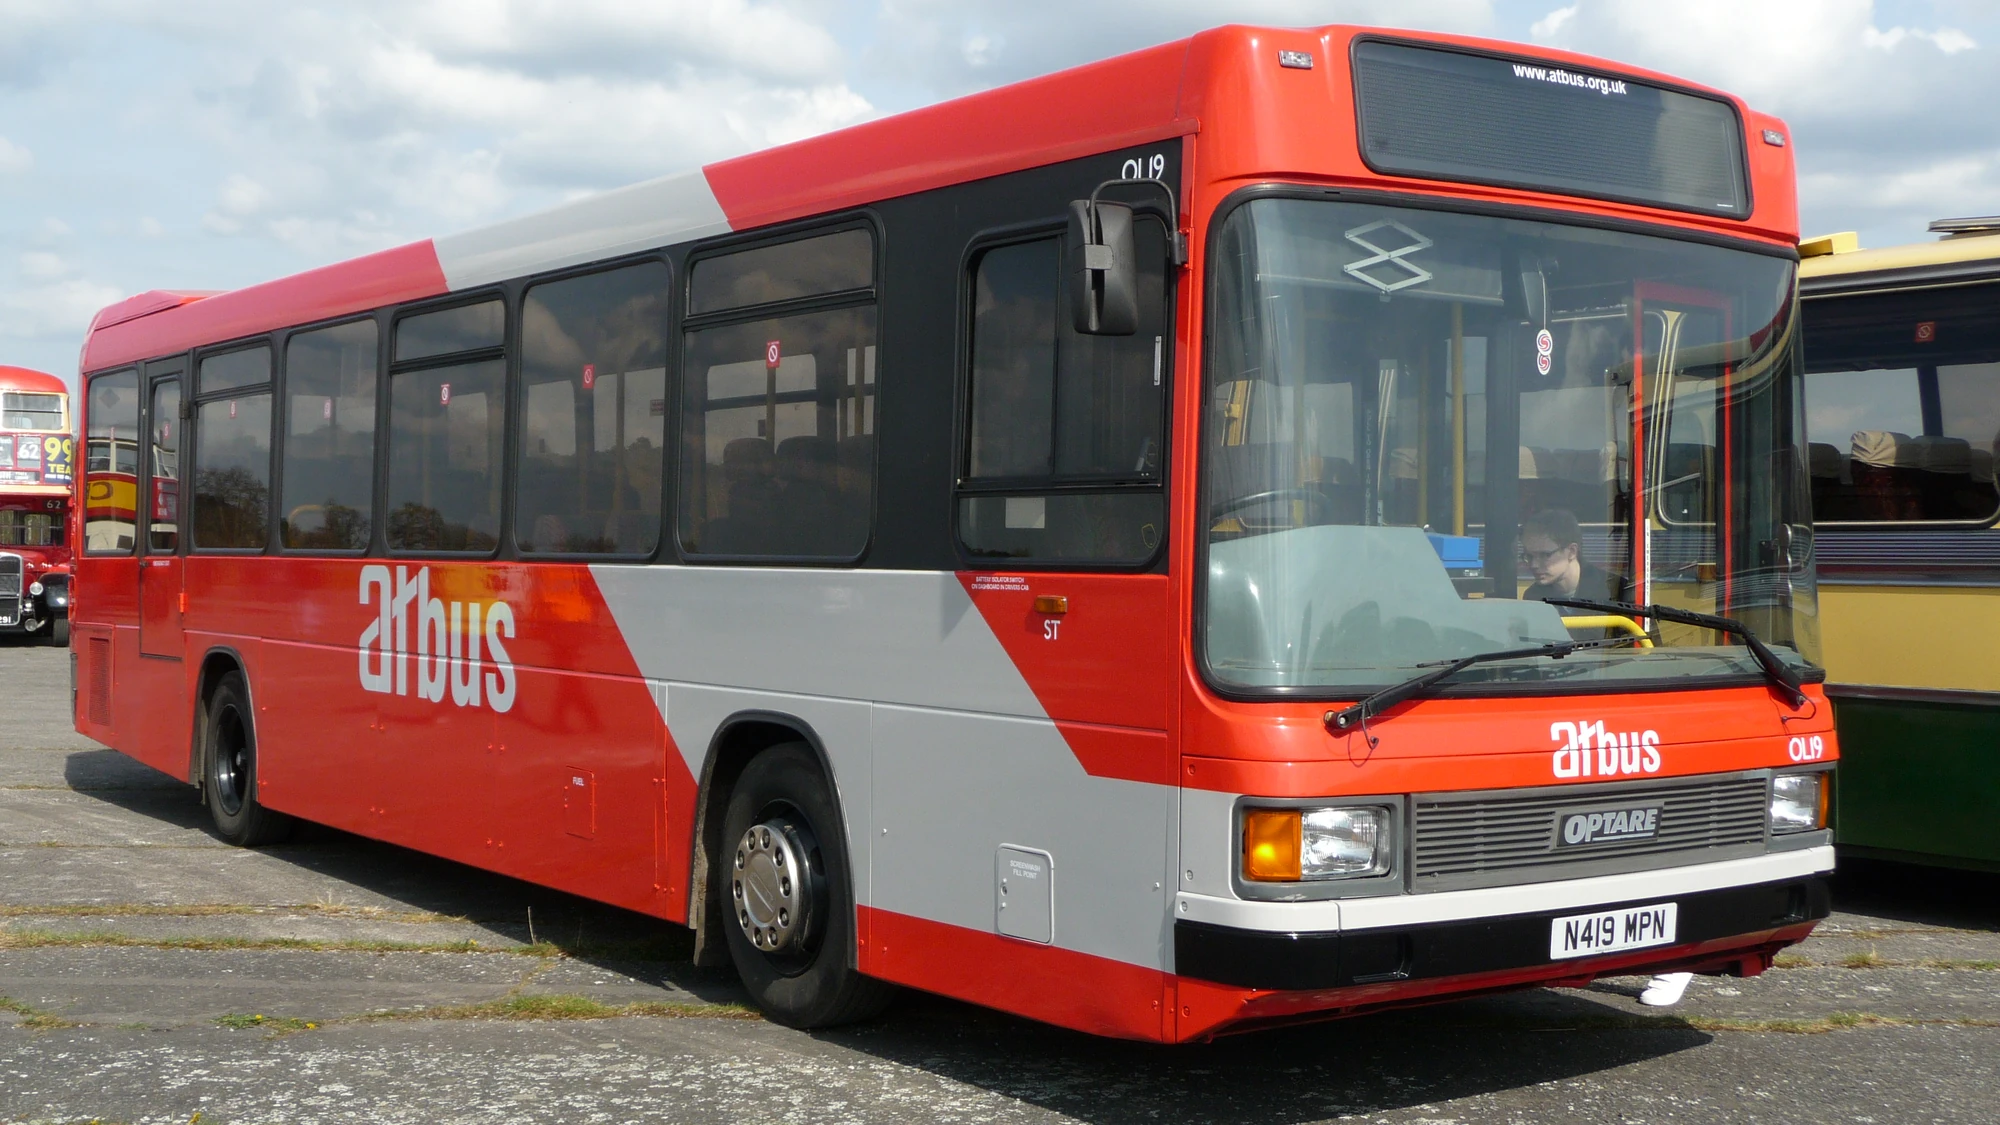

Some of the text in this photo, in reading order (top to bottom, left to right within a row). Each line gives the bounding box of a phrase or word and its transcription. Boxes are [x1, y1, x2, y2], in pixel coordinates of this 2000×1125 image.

[1512, 64, 1627, 95] www.atbus.org.uk
[18, 443, 39, 460] 62
[46, 500, 61, 509] 62
[359, 565, 516, 713] atbus
[1044, 619, 1060, 640] ST
[1550, 720, 1661, 778] atbus
[1789, 735, 1823, 762] OL19
[573, 776, 584, 786] FUEL
[1564, 809, 1658, 844] OPTARE
[1564, 909, 1666, 951] N419 MPN
